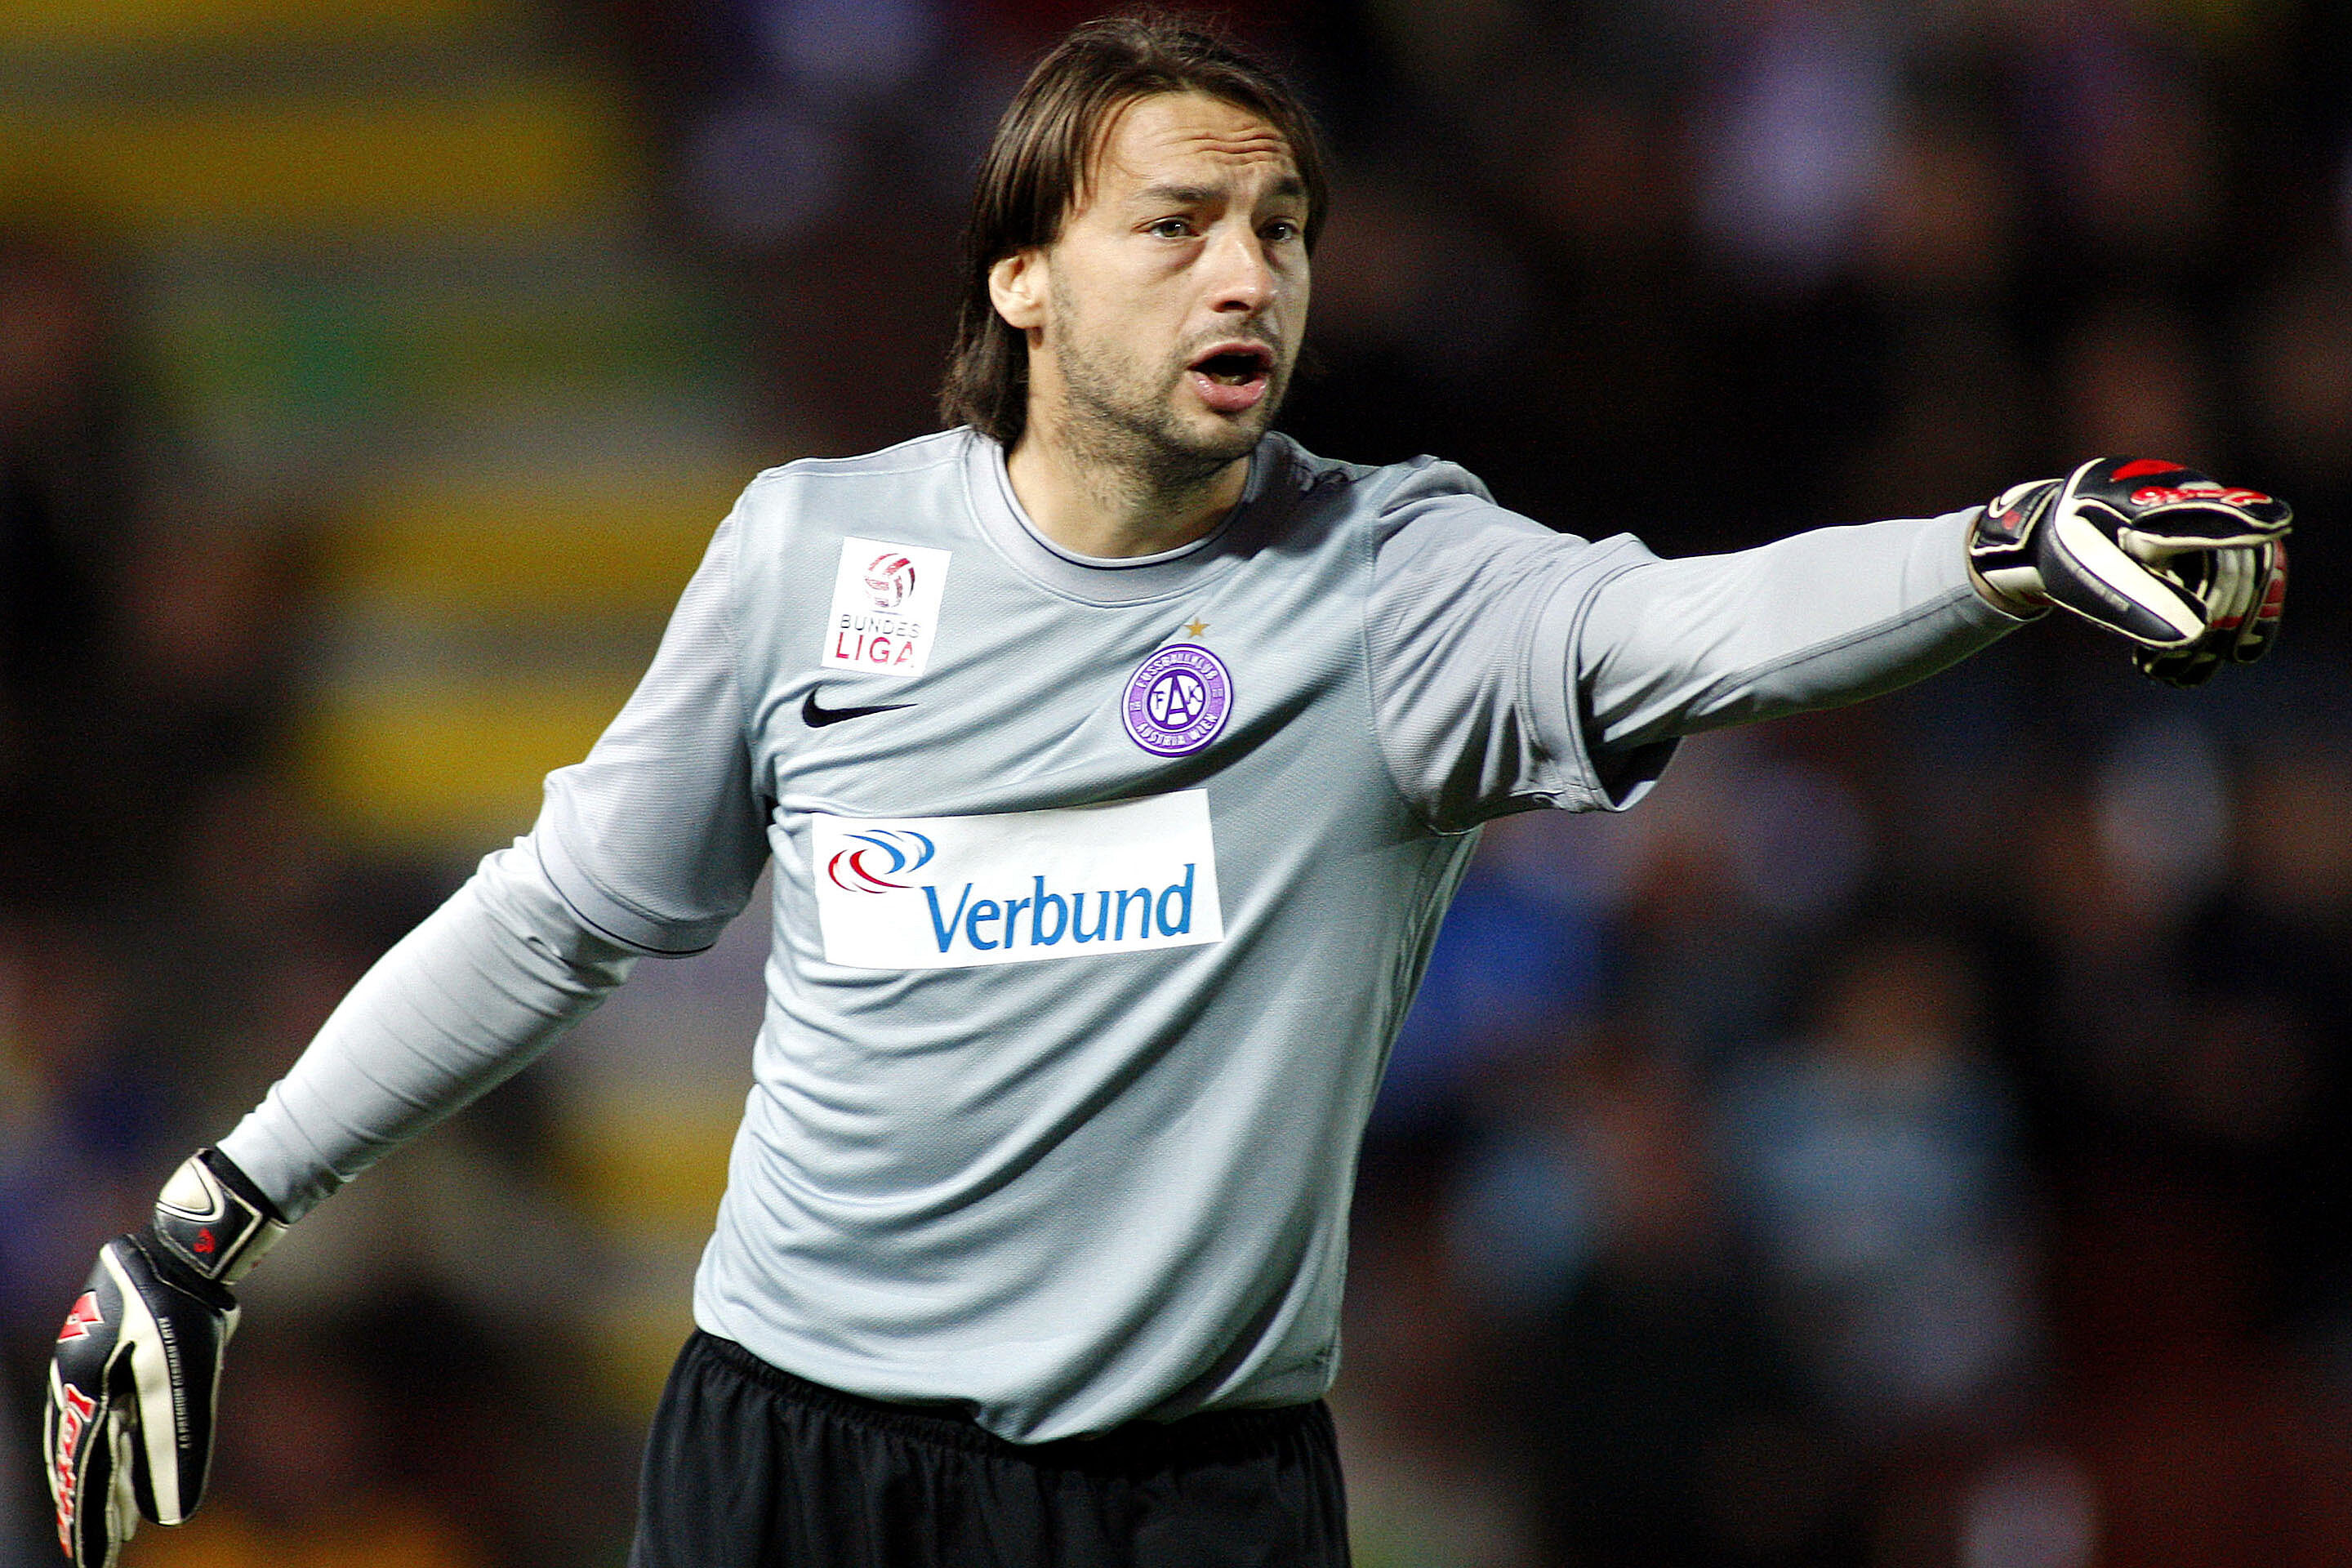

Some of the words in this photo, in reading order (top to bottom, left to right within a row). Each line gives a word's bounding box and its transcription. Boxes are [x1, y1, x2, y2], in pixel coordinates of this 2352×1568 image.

[840, 613, 922, 639] BUNDES
[835, 631, 915, 668] LIGA
[920, 862, 1196, 954] Verbund
